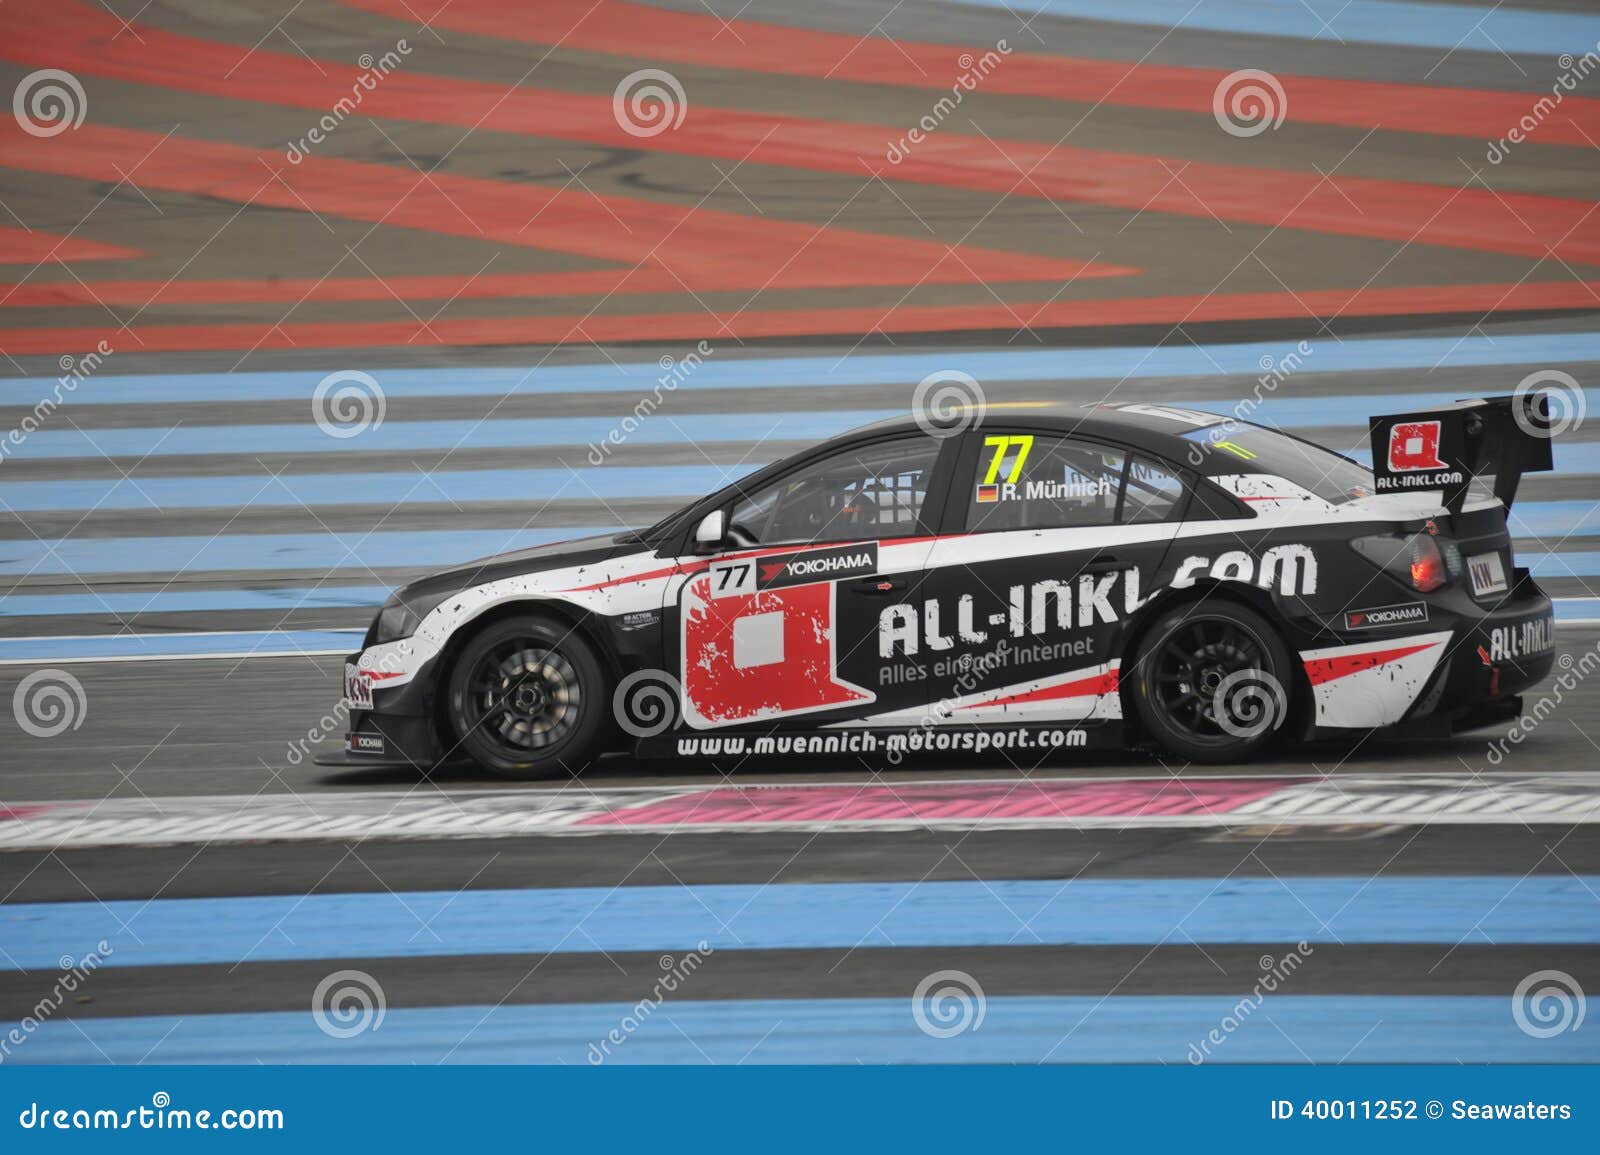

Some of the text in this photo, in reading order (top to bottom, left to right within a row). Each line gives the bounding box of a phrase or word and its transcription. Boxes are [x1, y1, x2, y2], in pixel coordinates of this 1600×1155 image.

[984, 435, 1034, 484] 77
[1002, 477, 1111, 501] R. Münnich
[786, 553, 872, 576] YOKOHAMA
[716, 565, 751, 590] 77
[1366, 607, 1424, 623] YOKOHAMA
[880, 664, 927, 685] Alles
[1014, 637, 1094, 664] Internet
[677, 728, 1088, 756] www.muennich-motorsport.com
